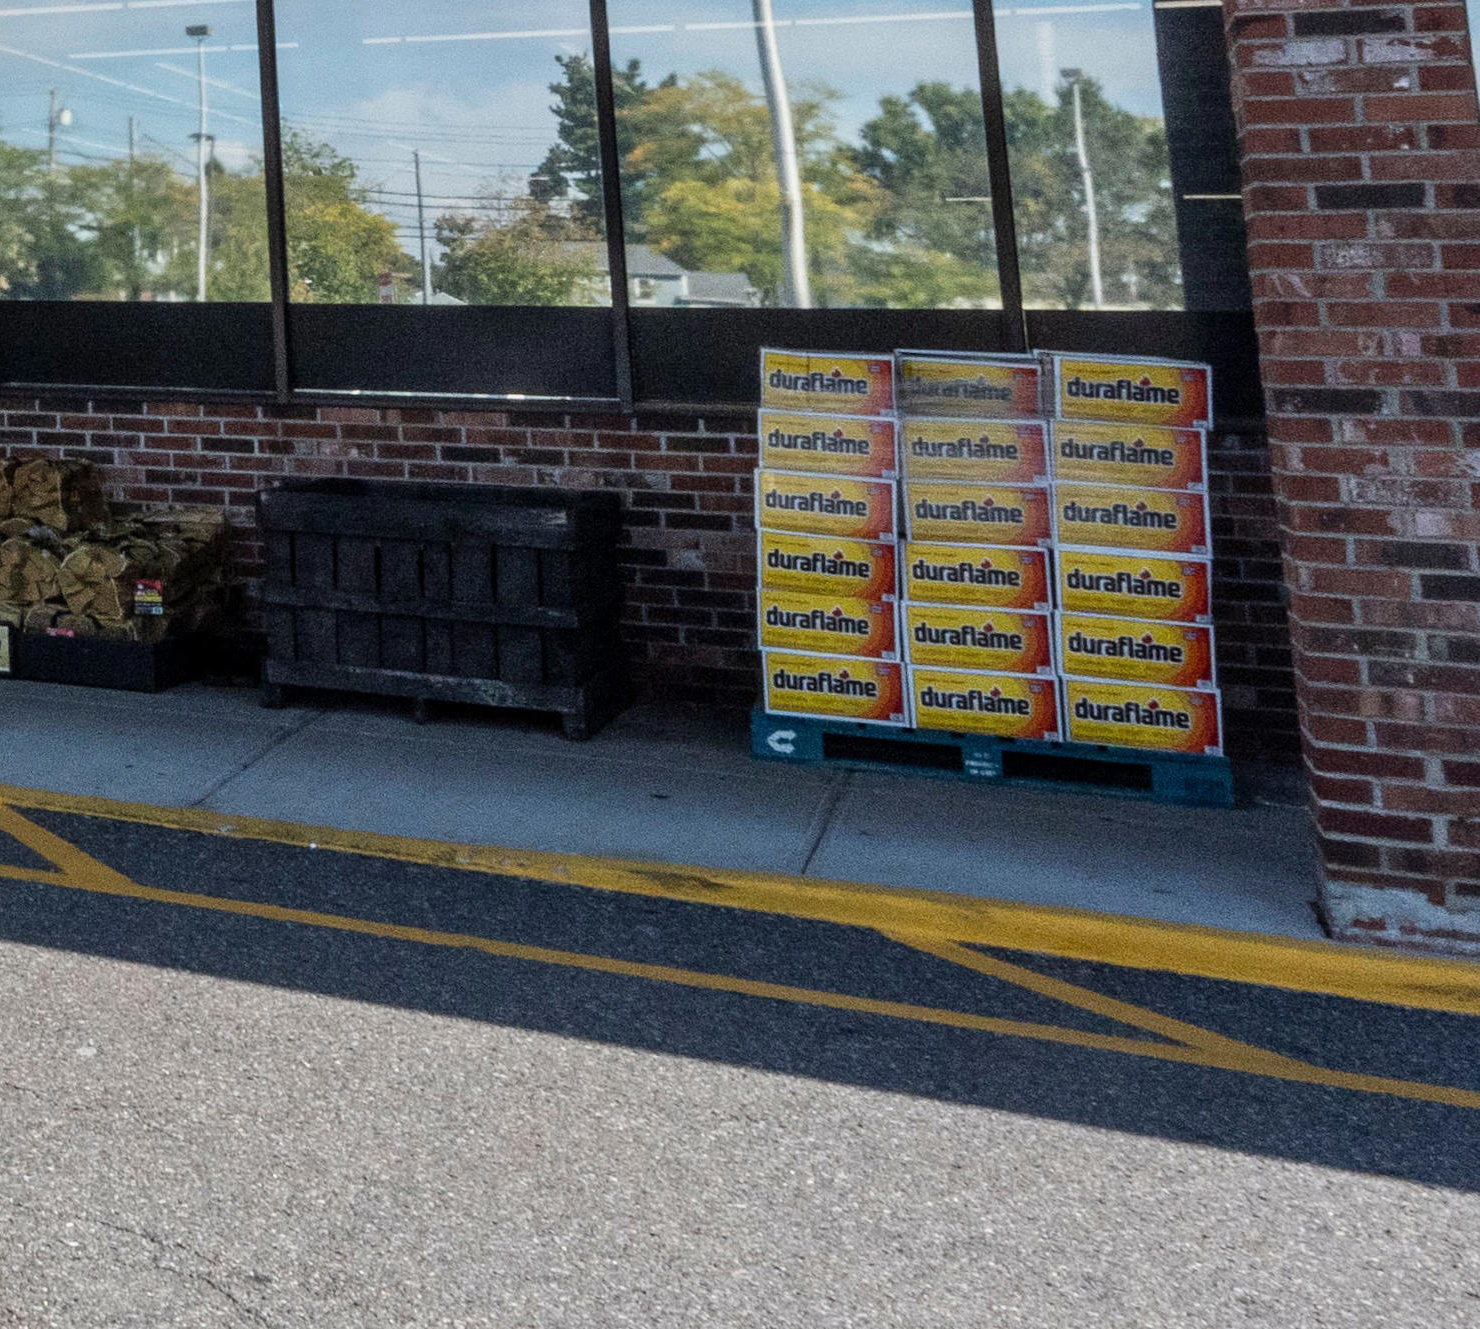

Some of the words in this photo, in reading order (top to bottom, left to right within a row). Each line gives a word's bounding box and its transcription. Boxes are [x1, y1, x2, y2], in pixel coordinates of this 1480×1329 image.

[770, 367, 868, 394] duraflame
[1067, 375, 1180, 405] duraflame
[767, 429, 870, 455] duraflame
[911, 435, 1018, 460] duraflame
[1060, 437, 1174, 466] duraflame
[766, 489, 867, 517] duraflame
[915, 497, 1023, 524] duraflame
[1064, 500, 1177, 530] duraflame
[767, 550, 870, 578] duraflame
[912, 559, 1020, 586] duraflame
[1067, 568, 1181, 598] duraflame
[766, 607, 869, 635] duraflame
[914, 622, 1022, 649] duraflame
[1068, 632, 1182, 663] duraflame
[774, 669, 877, 697] duraflame
[921, 687, 1030, 715] duraflame
[1075, 698, 1190, 729] duraflame
